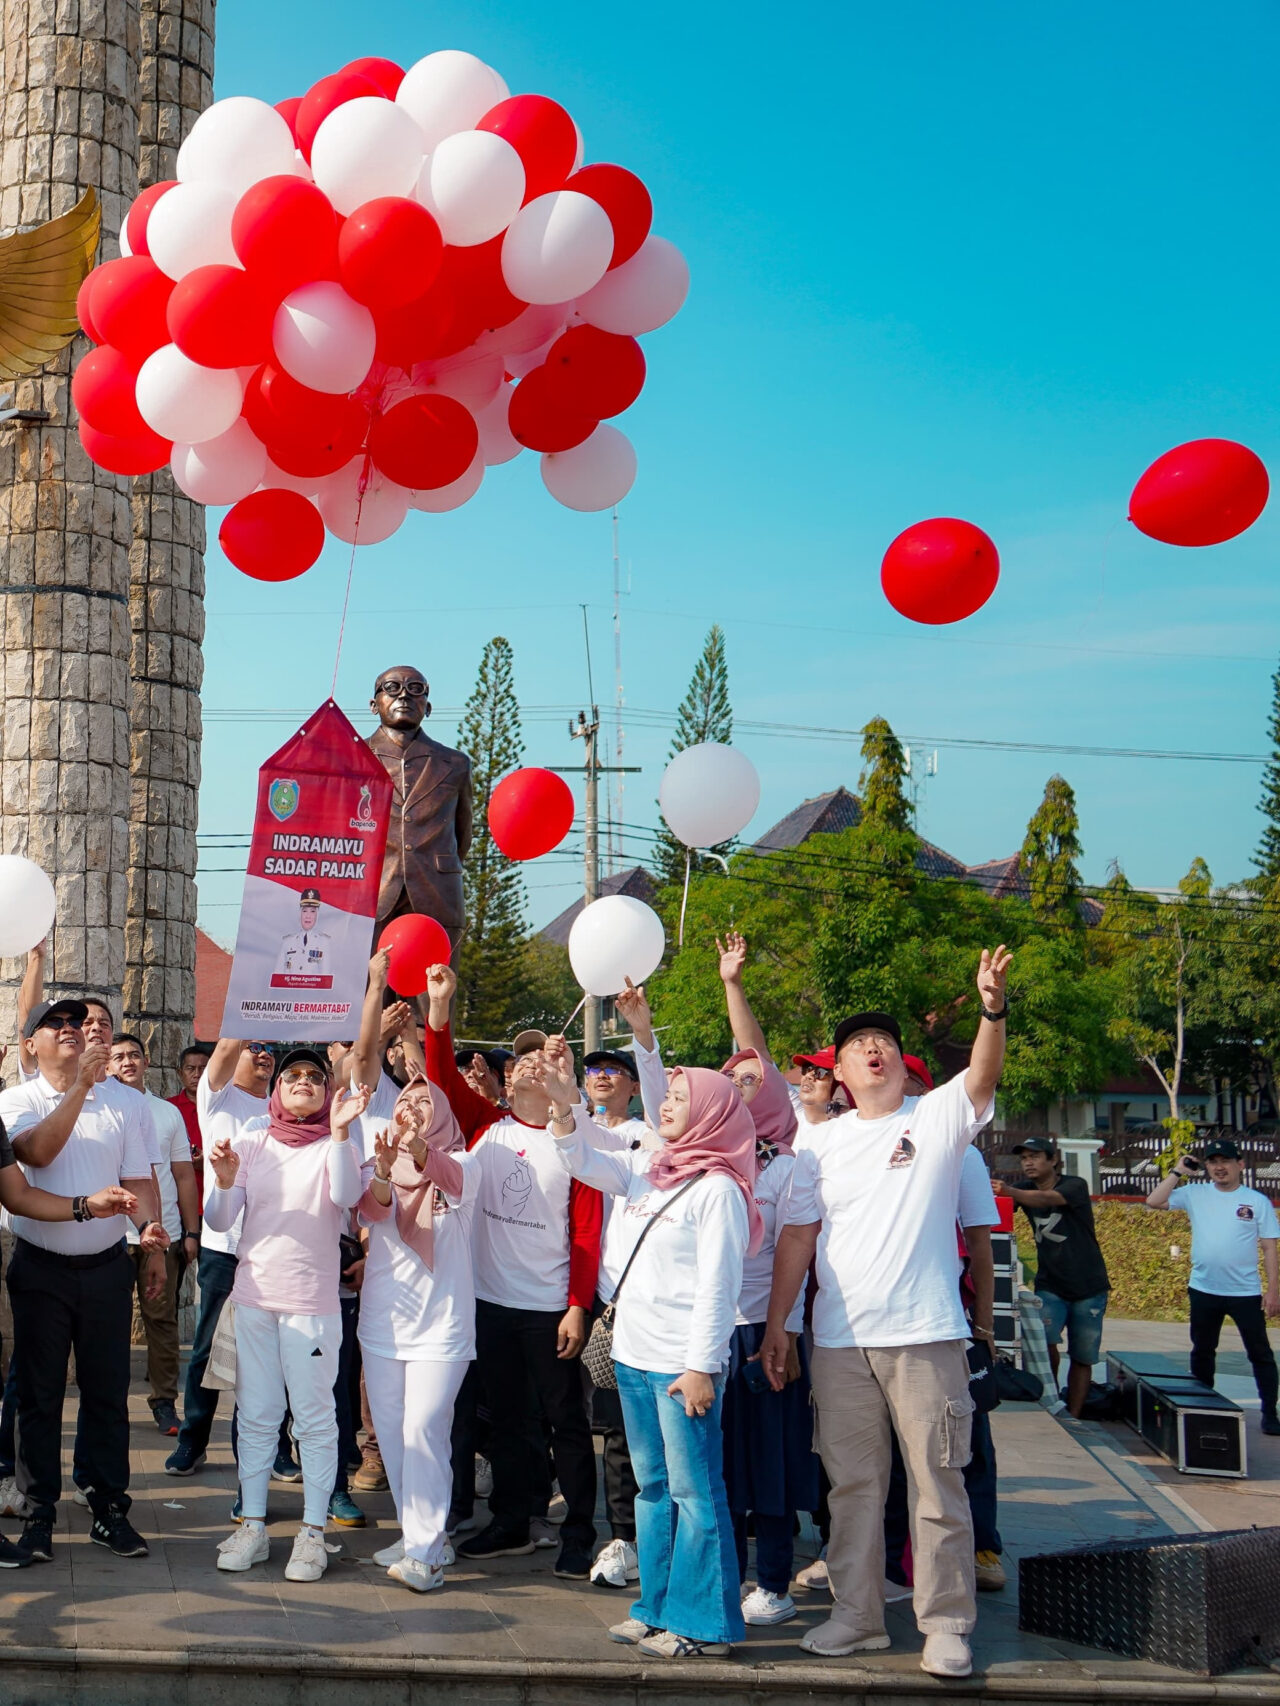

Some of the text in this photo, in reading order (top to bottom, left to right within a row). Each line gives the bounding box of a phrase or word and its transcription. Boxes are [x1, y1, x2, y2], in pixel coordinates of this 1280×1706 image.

[350, 820, 376, 829] bapenda
[272, 834, 365, 856] INDRAMAYU
[264, 857, 366, 880] SADAR PAJAK
[241, 1001, 350, 1013] INDRAMAYU BERMARTABAT
